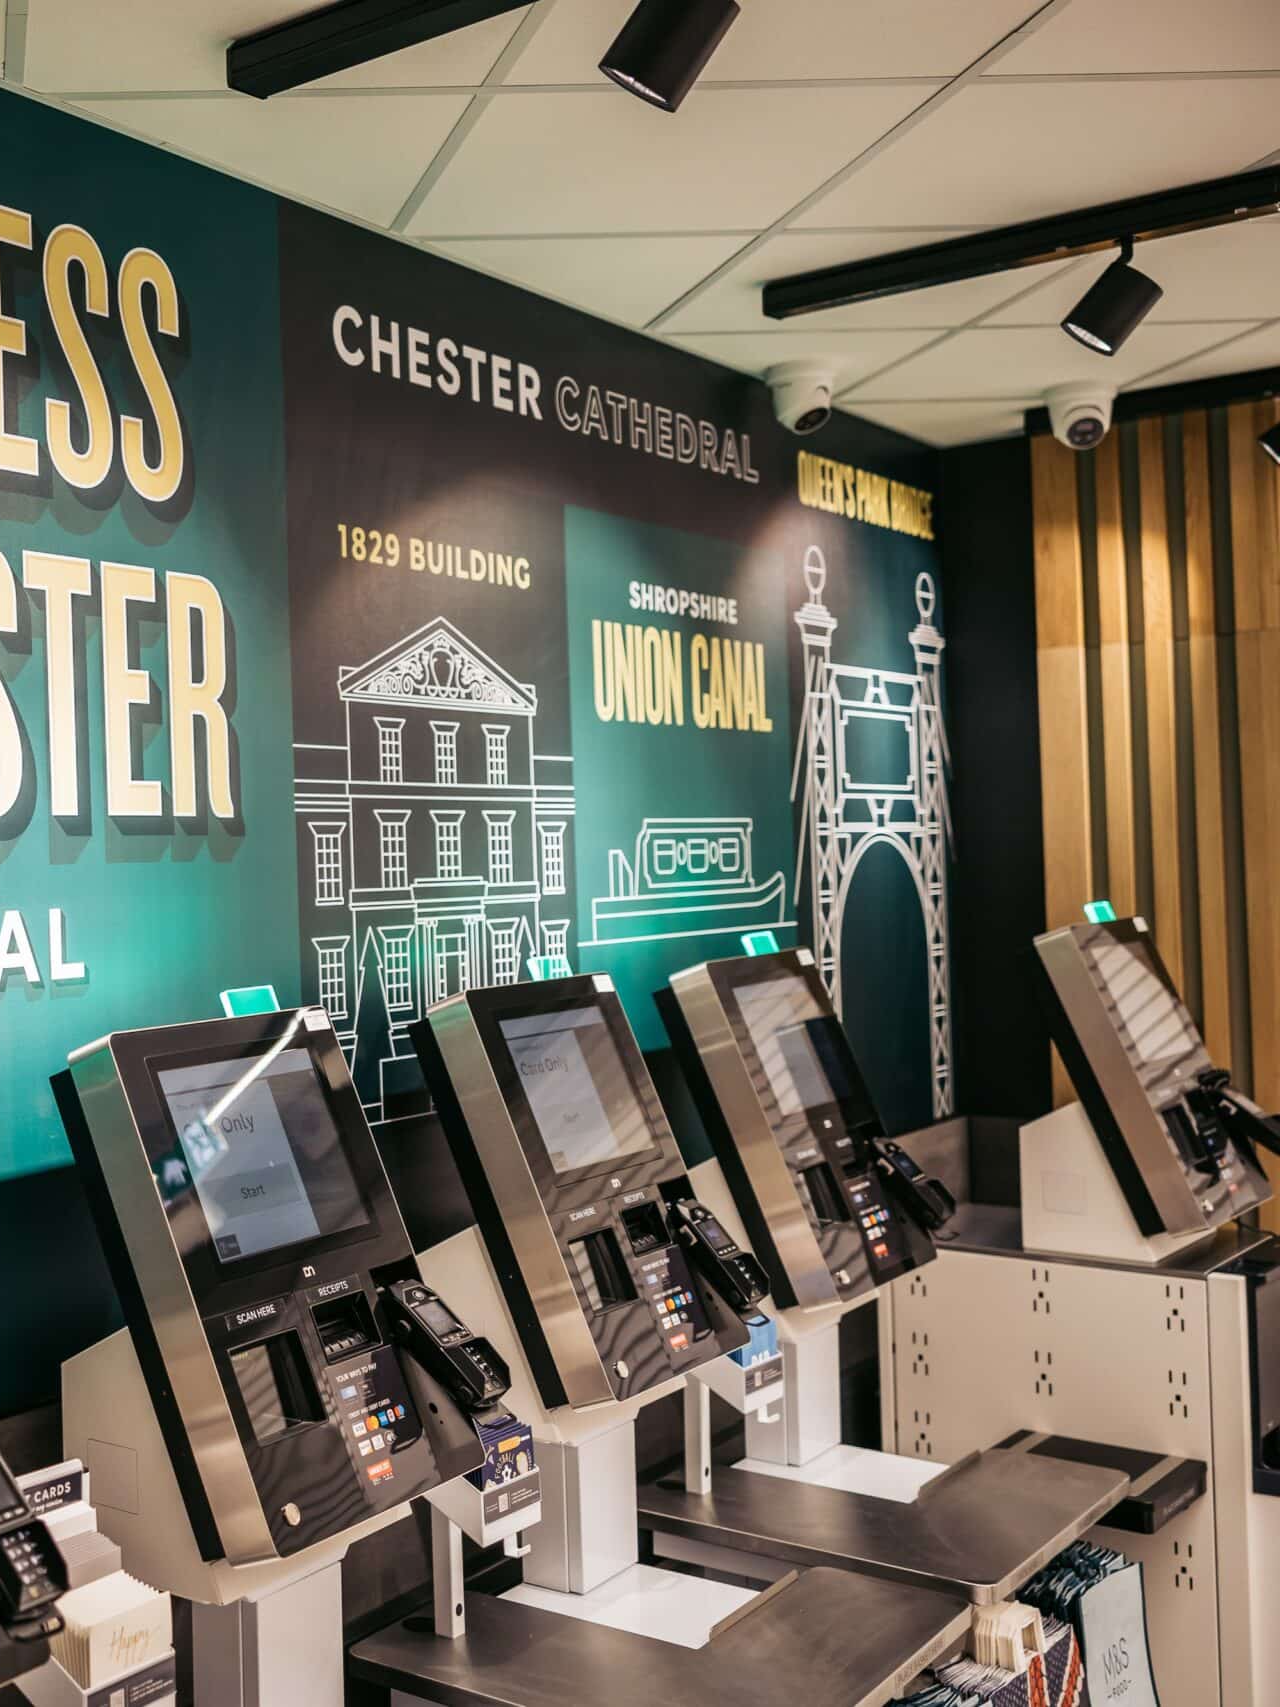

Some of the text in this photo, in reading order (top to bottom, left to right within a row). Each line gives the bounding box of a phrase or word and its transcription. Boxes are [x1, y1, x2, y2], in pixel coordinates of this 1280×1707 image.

[332, 304, 760, 484] CHESTER CATHEDRAL
[337, 523, 531, 589] 1829 BUILDING
[629, 580, 738, 625] SHROPSHIRE
[591, 619, 773, 733] UNION CANAL
[221, 1113, 255, 1133] Only
[240, 1184, 266, 1199] Start
[318, 1280, 350, 1297] RECEIPTS
[236, 1303, 278, 1324] SCAN HERE
[34, 1481, 72, 1503] CARDS
[1102, 1636, 1130, 1685] M&S
